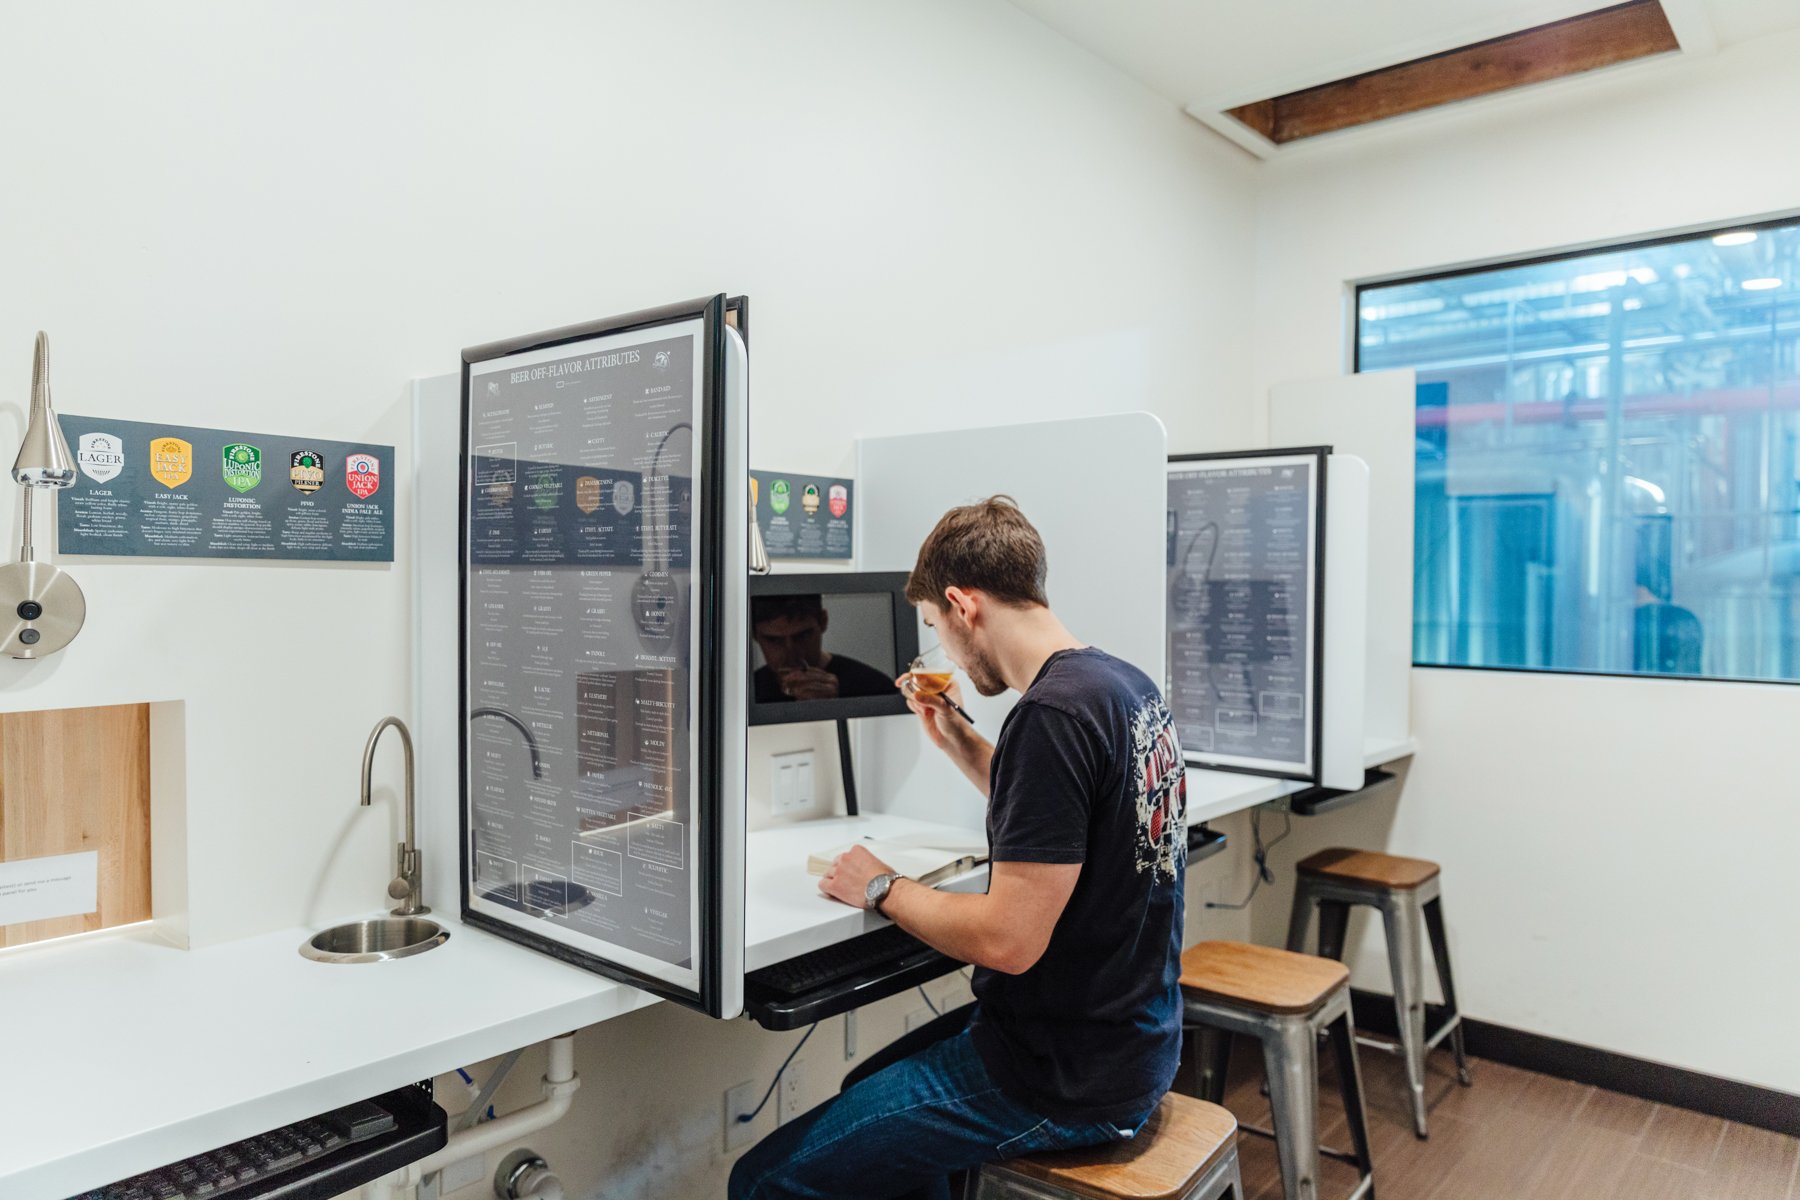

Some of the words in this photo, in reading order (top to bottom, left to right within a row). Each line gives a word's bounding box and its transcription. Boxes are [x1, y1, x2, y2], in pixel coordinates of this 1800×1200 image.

[510, 370, 530, 384] BEER
[530, 360, 583, 380] OFF-FLAVOR
[583, 349, 640, 371] ATTRIBUTES
[80, 452, 122, 464] LAGER
[155, 452, 187, 464] EASY
[229, 445, 255, 461] FIRESTONE
[223, 458, 261, 471] LUPONIC
[293, 451, 322, 468] FIRESTONE
[156, 462, 187, 473] JACK
[223, 468, 261, 480] DISTORTION
[291, 468, 322, 479] PIVO
[348, 473, 378, 483] UNION
[232, 477, 251, 487] IPA
[352, 480, 373, 490] JACK
[357, 488, 368, 496] IPA
[223, 502, 262, 510] DISTORTION
